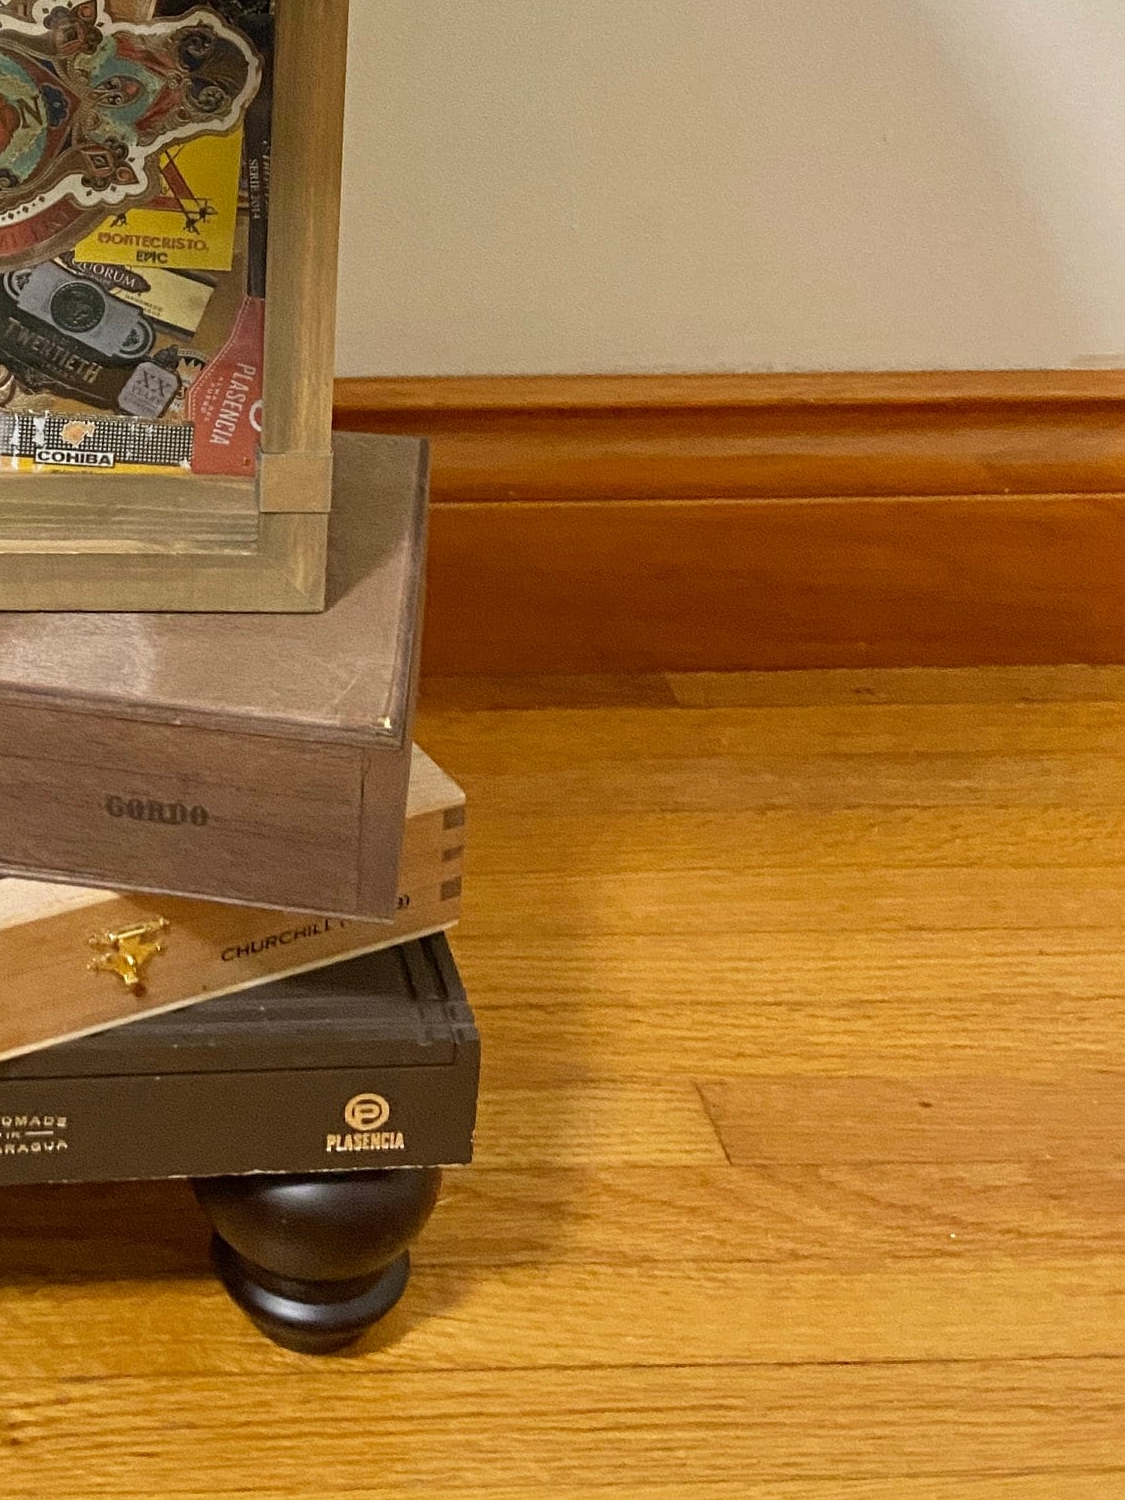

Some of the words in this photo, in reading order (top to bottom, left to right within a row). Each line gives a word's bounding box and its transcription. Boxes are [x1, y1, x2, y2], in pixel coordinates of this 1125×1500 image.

[136, 251, 168, 264] EPIC
[5, 317, 103, 383] TWENTIETH
[209, 362, 256, 445] PLASENCIA
[37, 450, 112, 466] COHIBA
[105, 795, 209, 826] GORDO
[326, 1131, 405, 1153] PLASENCIA
